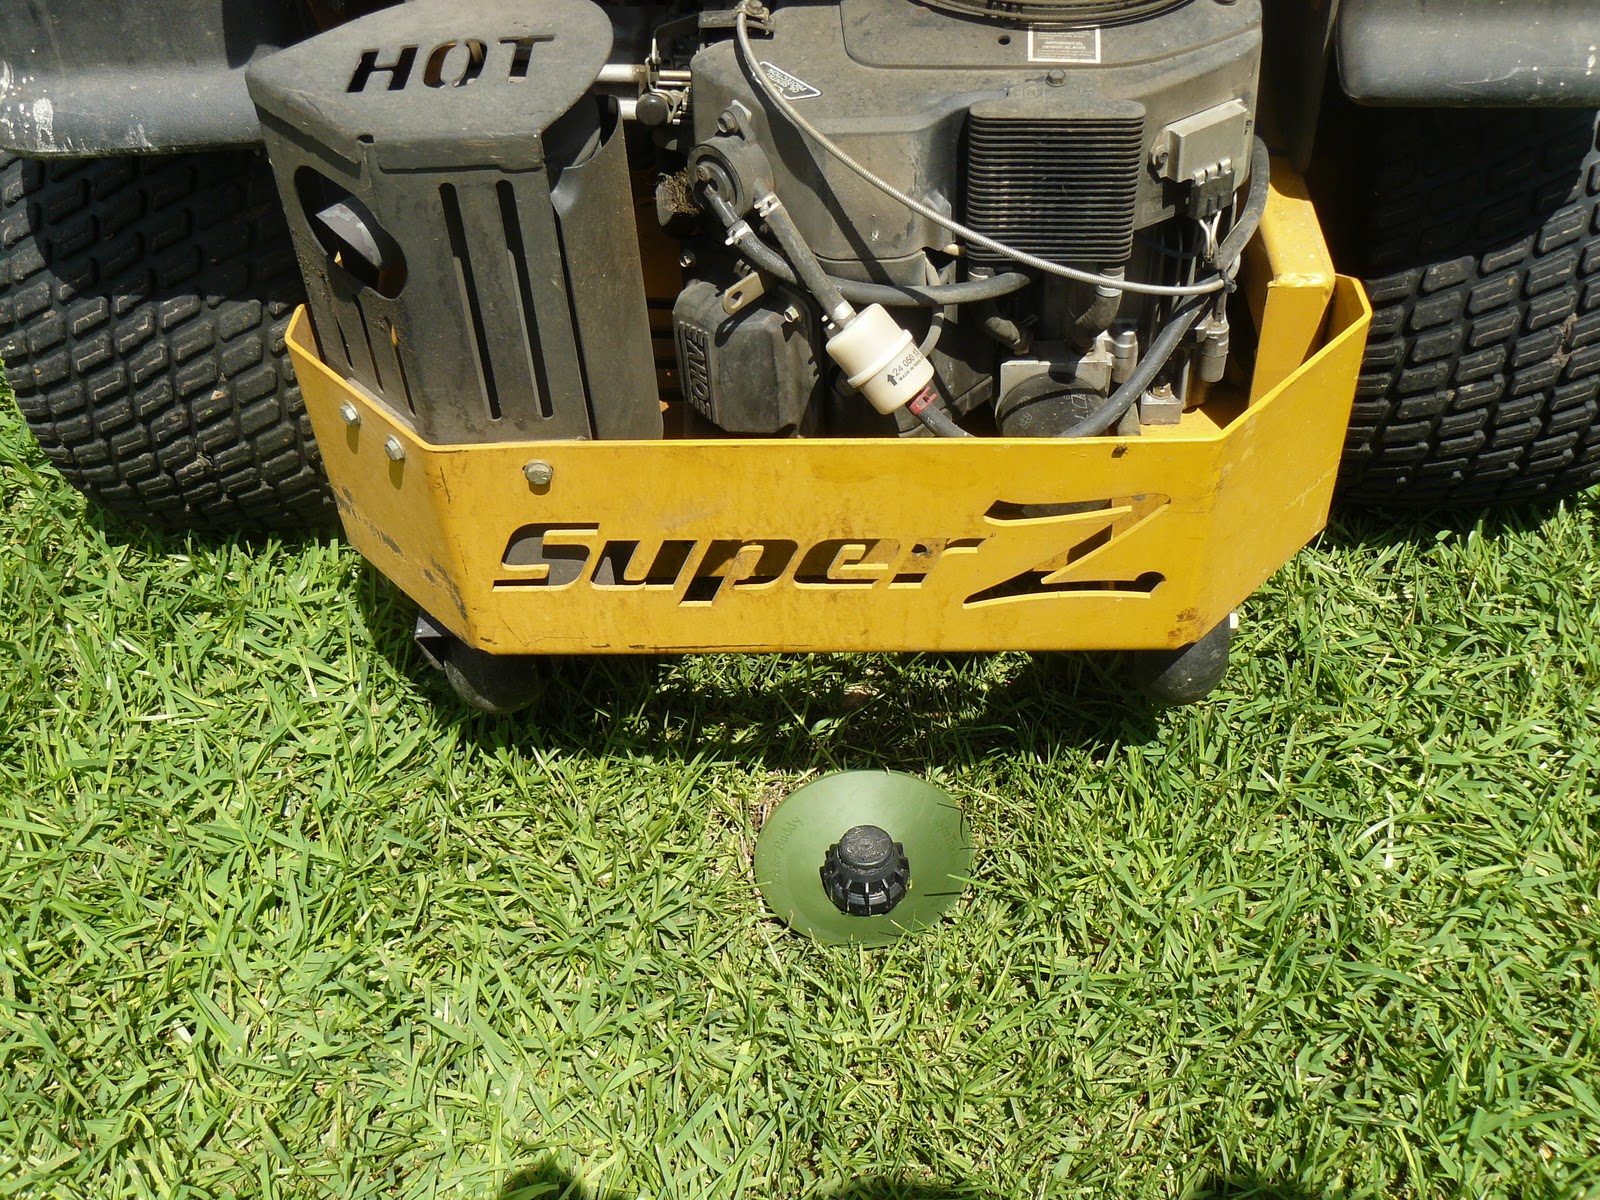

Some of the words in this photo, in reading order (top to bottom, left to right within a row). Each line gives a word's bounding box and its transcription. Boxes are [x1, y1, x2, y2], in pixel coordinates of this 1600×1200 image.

[347, 34, 556, 93] HOT
[892, 365, 904, 376] 24
[902, 353, 915, 367] 050
[492, 522, 986, 608] Super
[962, 493, 1171, 610] Z
[774, 816, 804, 851] Buddy
